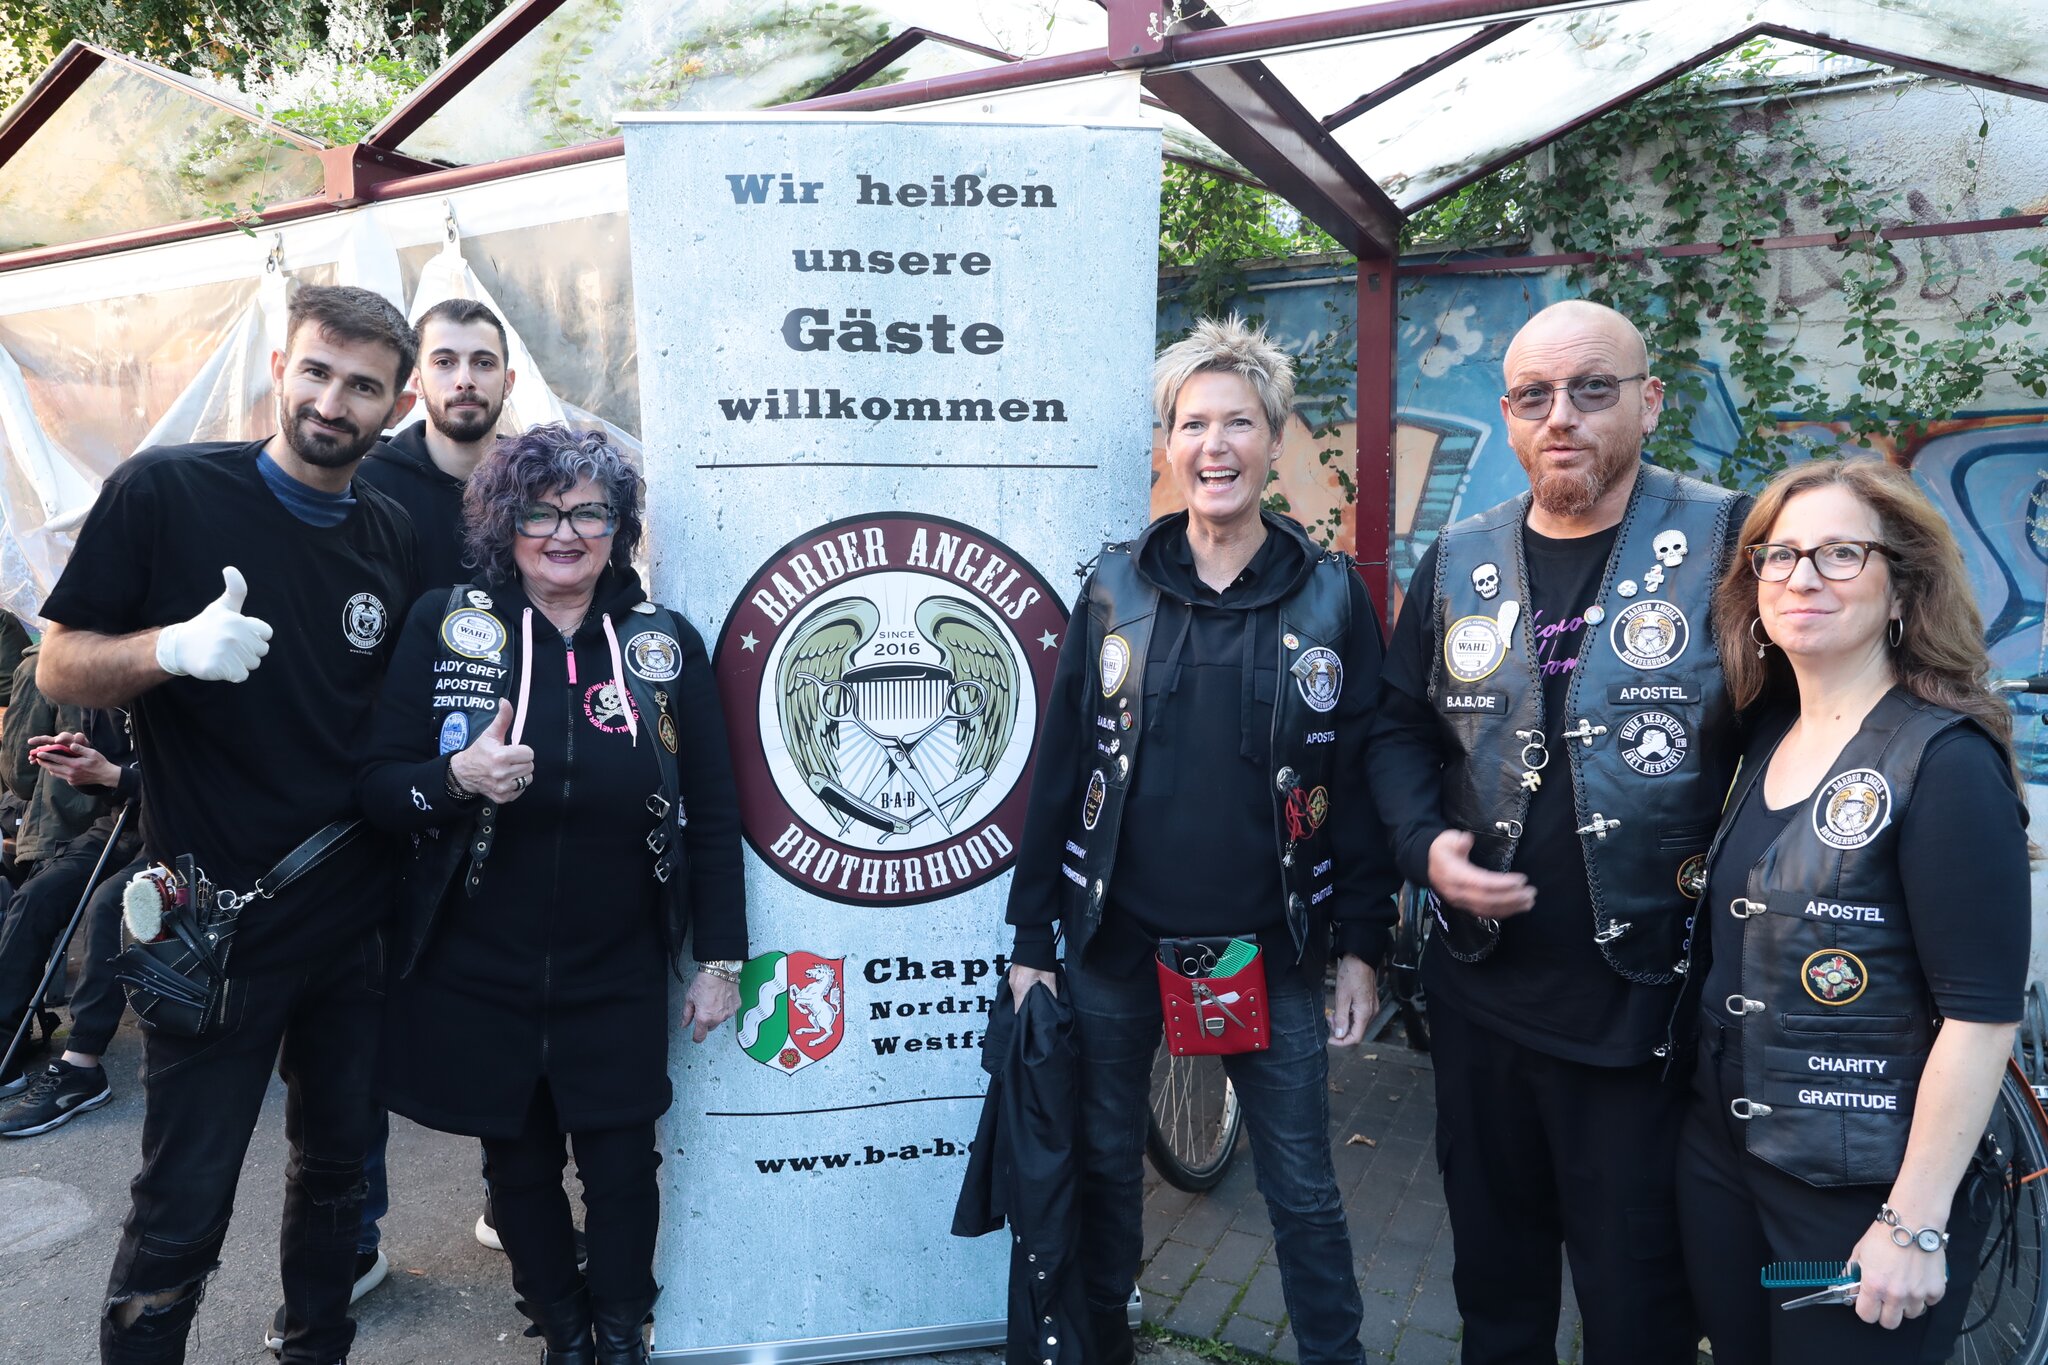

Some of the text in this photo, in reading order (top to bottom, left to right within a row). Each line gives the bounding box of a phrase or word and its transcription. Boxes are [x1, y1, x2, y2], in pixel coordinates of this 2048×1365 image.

[725, 173, 1057, 208] Wir heißen
[793, 248, 991, 276] unsere
[780, 307, 1004, 355] Gäste
[718, 388, 1068, 423] willkommen
[751, 527, 1040, 626] BARBER ANGELS
[461, 626, 490, 640] WAHL
[879, 631, 915, 639] SINCE
[874, 642, 920, 656] 2016
[1459, 643, 1487, 652] WAHL
[433, 660, 507, 679] LADY GREY
[435, 678, 495, 694] APOSTEL
[1620, 686, 1687, 700] APOSTEL
[433, 695, 495, 710] ZENTURIO
[1623, 714, 1682, 738] GIVE RESPECT
[1625, 751, 1681, 773] GET RESPECT
[770, 823, 1014, 895] BROTHERHOOD
[1804, 901, 1885, 922] APOSTEL
[1808, 1056, 1887, 1074] CHARITY
[1798, 1089, 1897, 1111] GRATITUDE
